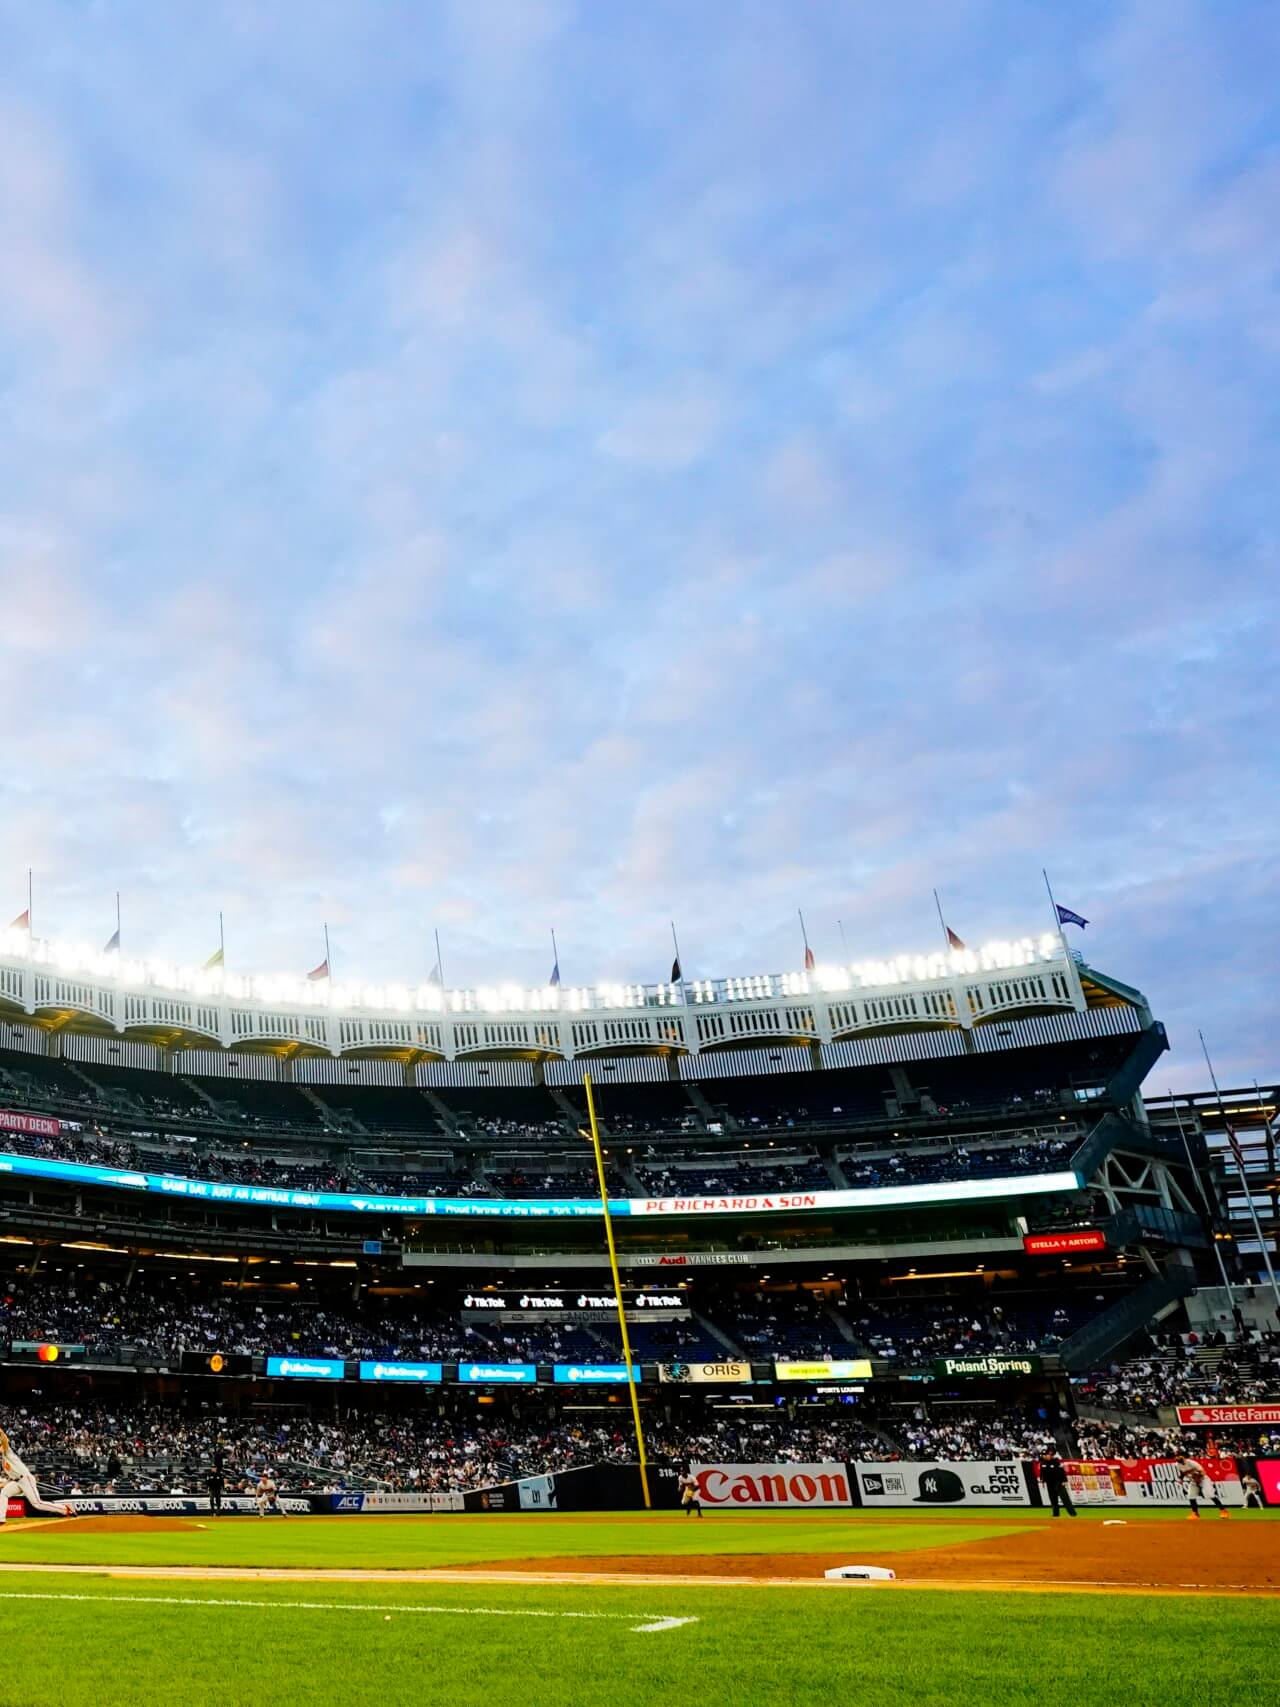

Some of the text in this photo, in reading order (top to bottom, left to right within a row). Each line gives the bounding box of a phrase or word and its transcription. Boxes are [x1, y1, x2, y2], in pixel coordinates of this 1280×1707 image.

[29, 1118, 54, 1133] DECK
[646, 1195, 816, 1211] PC RICHARD & SON
[1031, 1237, 1098, 1249] STELLA ARTOIS
[659, 1255, 687, 1265] Audi
[727, 1254, 750, 1264] CLUB
[474, 1297, 506, 1307] TikTok
[530, 1297, 564, 1307] TikTok
[648, 1295, 682, 1307] TikTok
[702, 1364, 740, 1376] ORIS
[945, 1358, 1032, 1374] Poland Spring
[1211, 1408, 1280, 1421] State Farm
[994, 1465, 1016, 1475] FIT
[989, 1475, 1019, 1485] FOR
[696, 1469, 849, 1503] Canon
[970, 1485, 1019, 1494] GLORY
[75, 1501, 99, 1511] COOL
[120, 1501, 144, 1510] COOL
[164, 1500, 187, 1510] COOL
[338, 1497, 360, 1506] ACC
[291, 1502, 310, 1512] COOL
